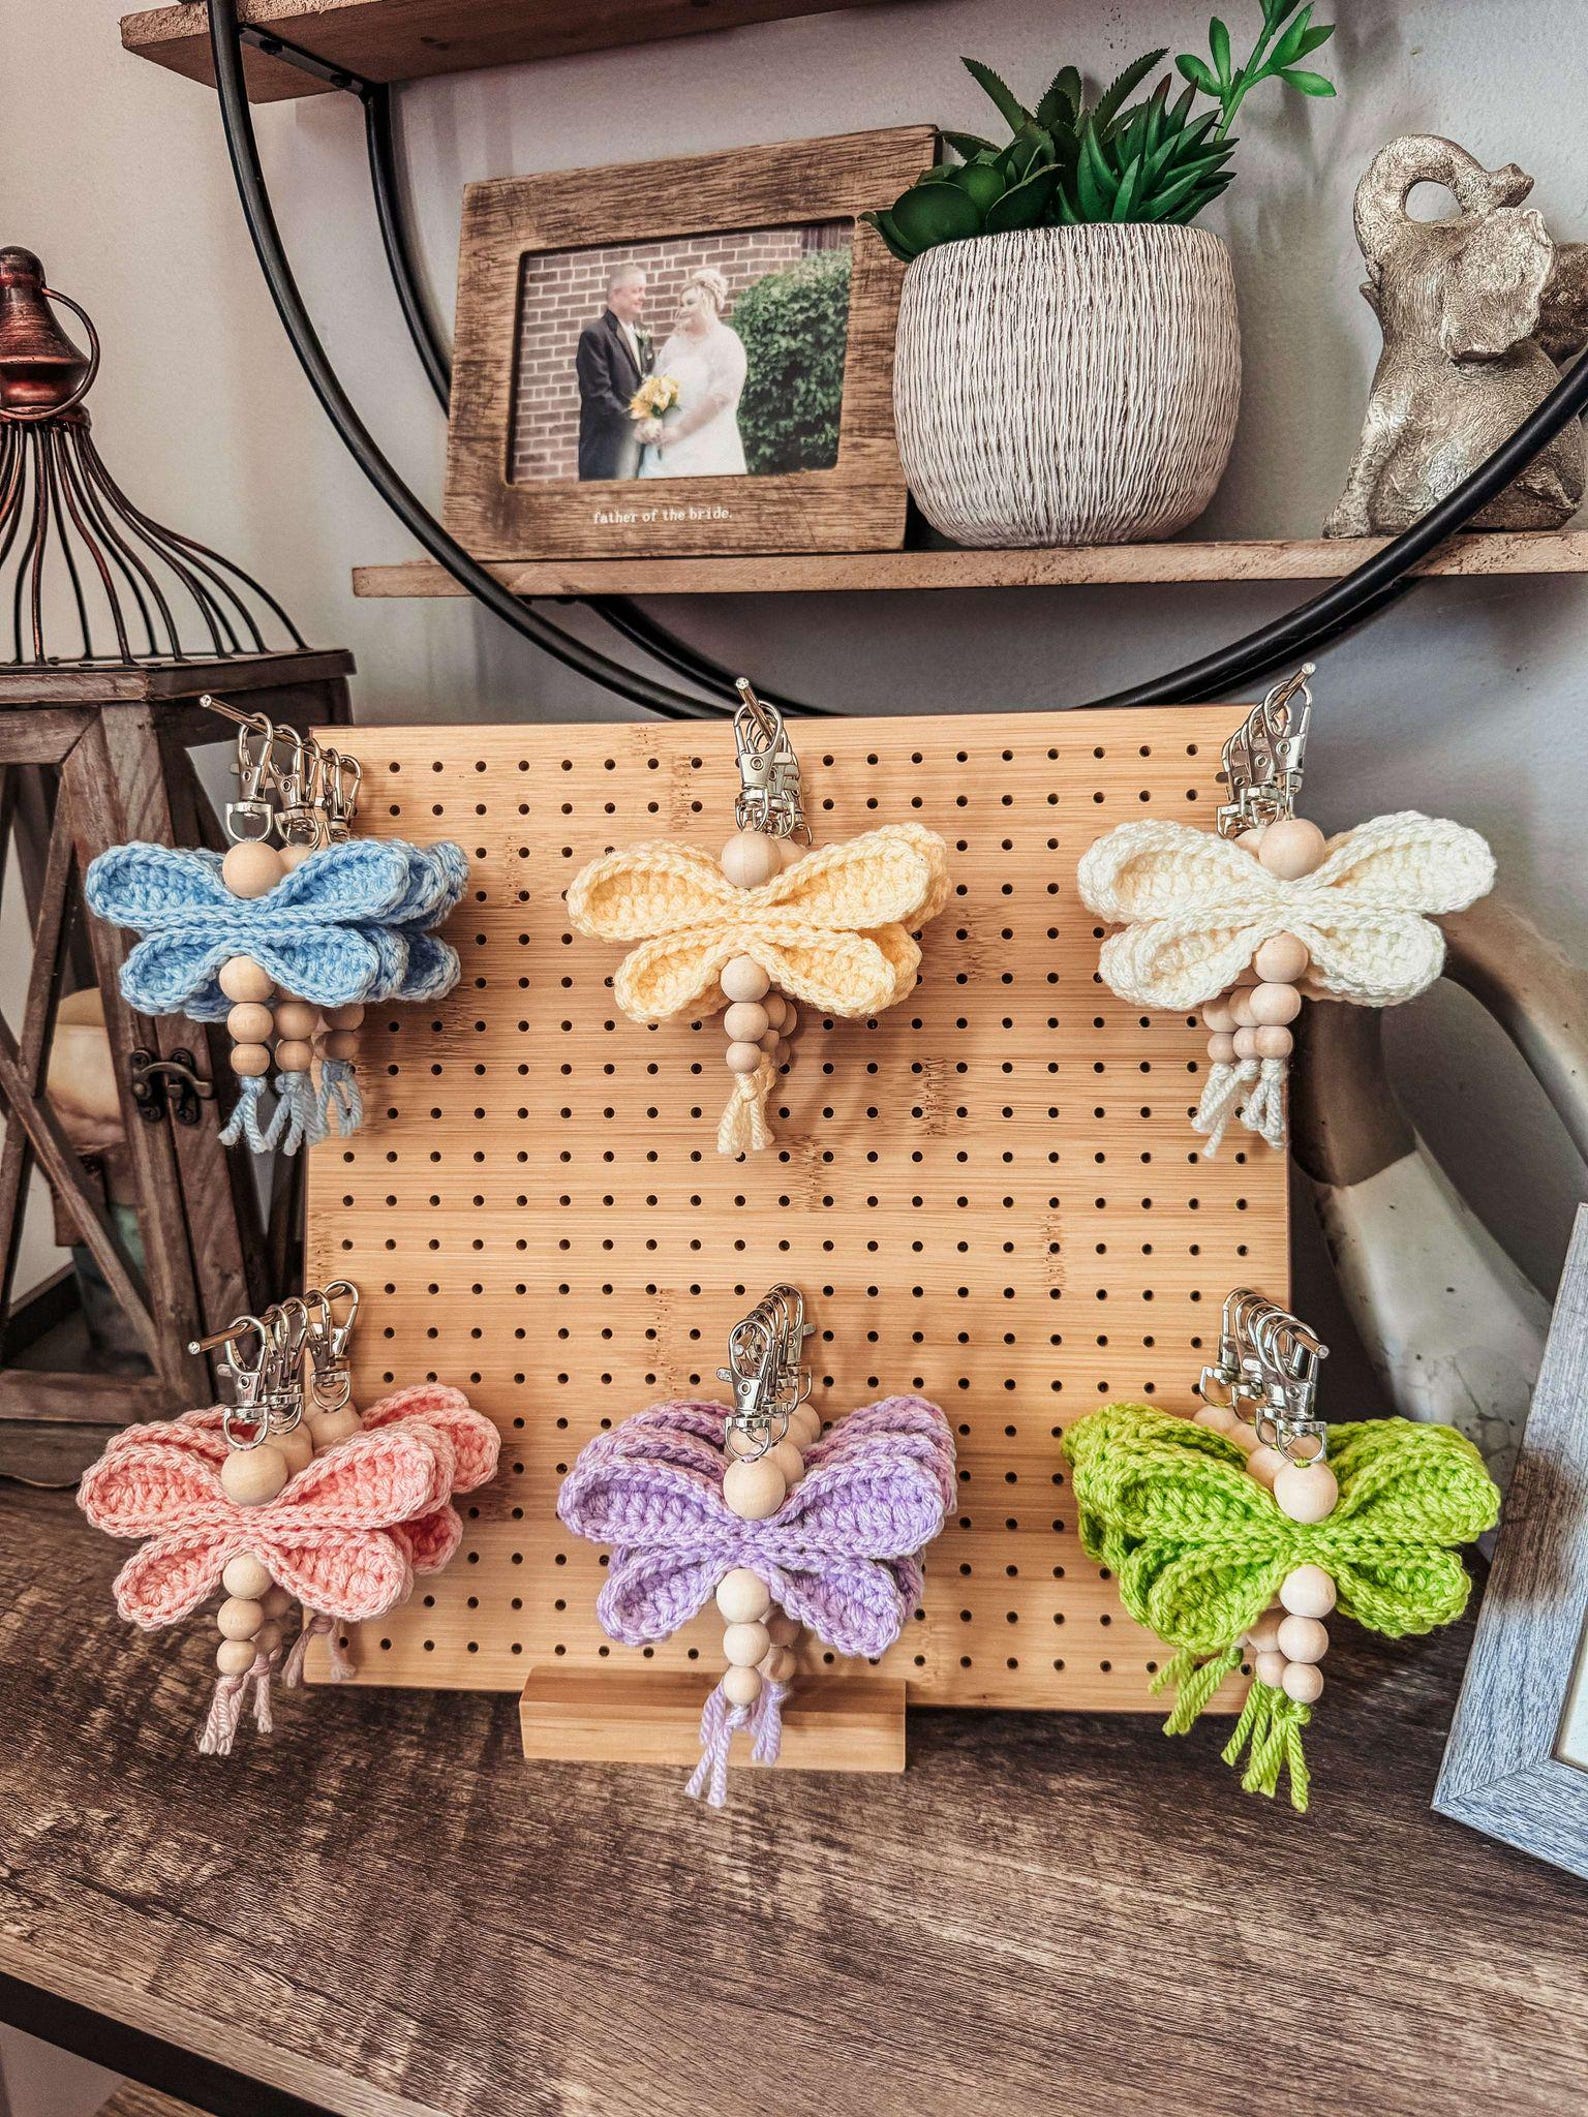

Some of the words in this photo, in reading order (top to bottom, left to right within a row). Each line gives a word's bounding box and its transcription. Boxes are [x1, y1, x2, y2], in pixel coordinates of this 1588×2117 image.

[594, 511, 637, 524] father
[642, 508, 658, 522] of
[662, 508, 685, 521] the
[689, 506, 732, 520] bride.
